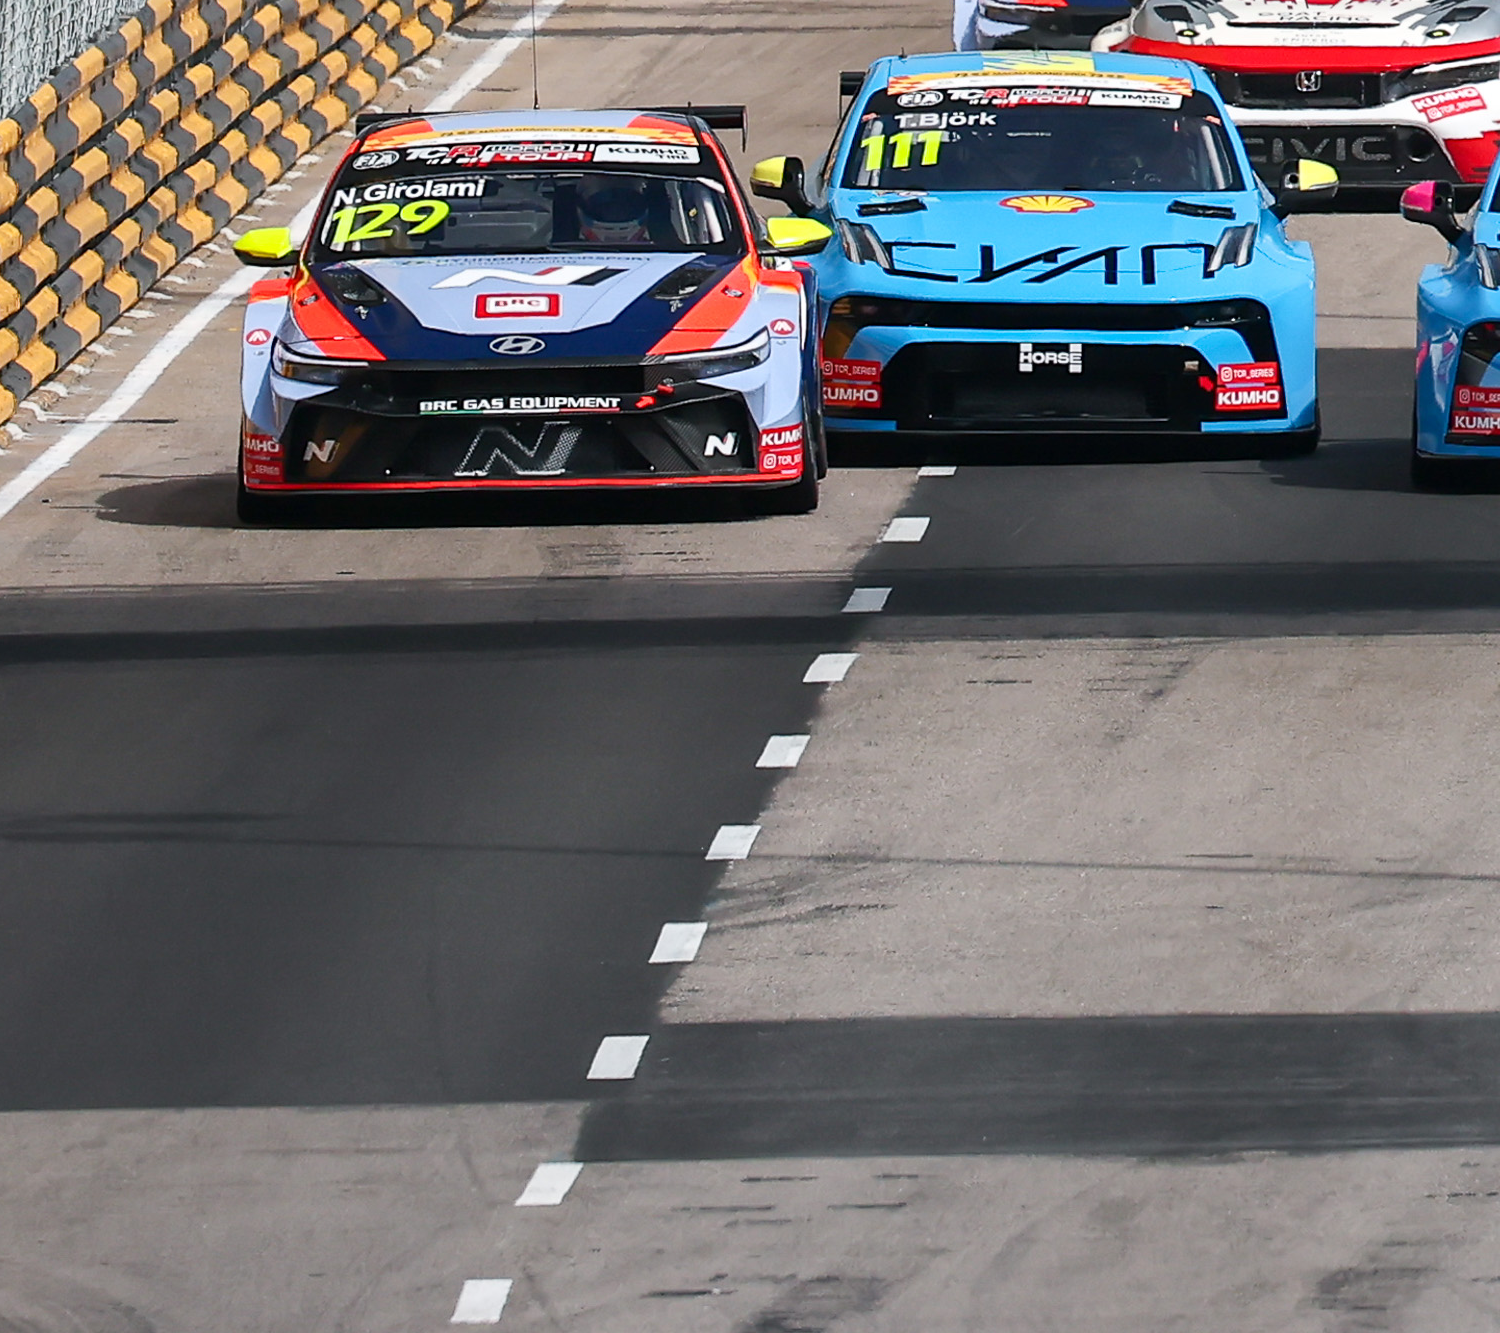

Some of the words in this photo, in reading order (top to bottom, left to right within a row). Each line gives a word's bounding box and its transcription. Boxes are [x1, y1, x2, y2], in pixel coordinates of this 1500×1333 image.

[899, 93, 941, 107] FIA
[948, 88, 1009, 102] TCR
[1019, 95, 1083, 105] TOUR
[1101, 92, 1170, 101] KUMHO
[1414, 87, 1479, 110] KUMHO
[895, 111, 997, 129] T.Björk
[405, 144, 481, 161] TCR
[496, 151, 591, 163] TOUR
[609, 147, 687, 156] KUMHO
[654, 153, 690, 161] TIRE
[860, 130, 943, 172] 111
[355, 151, 399, 170] FIA
[331, 178, 486, 208] N.Girolami
[331, 199, 450, 245] 129
[493, 297, 542, 308] BRC
[420, 400, 458, 412] BRC
[463, 399, 504, 411] GAS
[510, 397, 621, 410] EQUIPMENT
[1217, 390, 1279, 407] KUMHO
